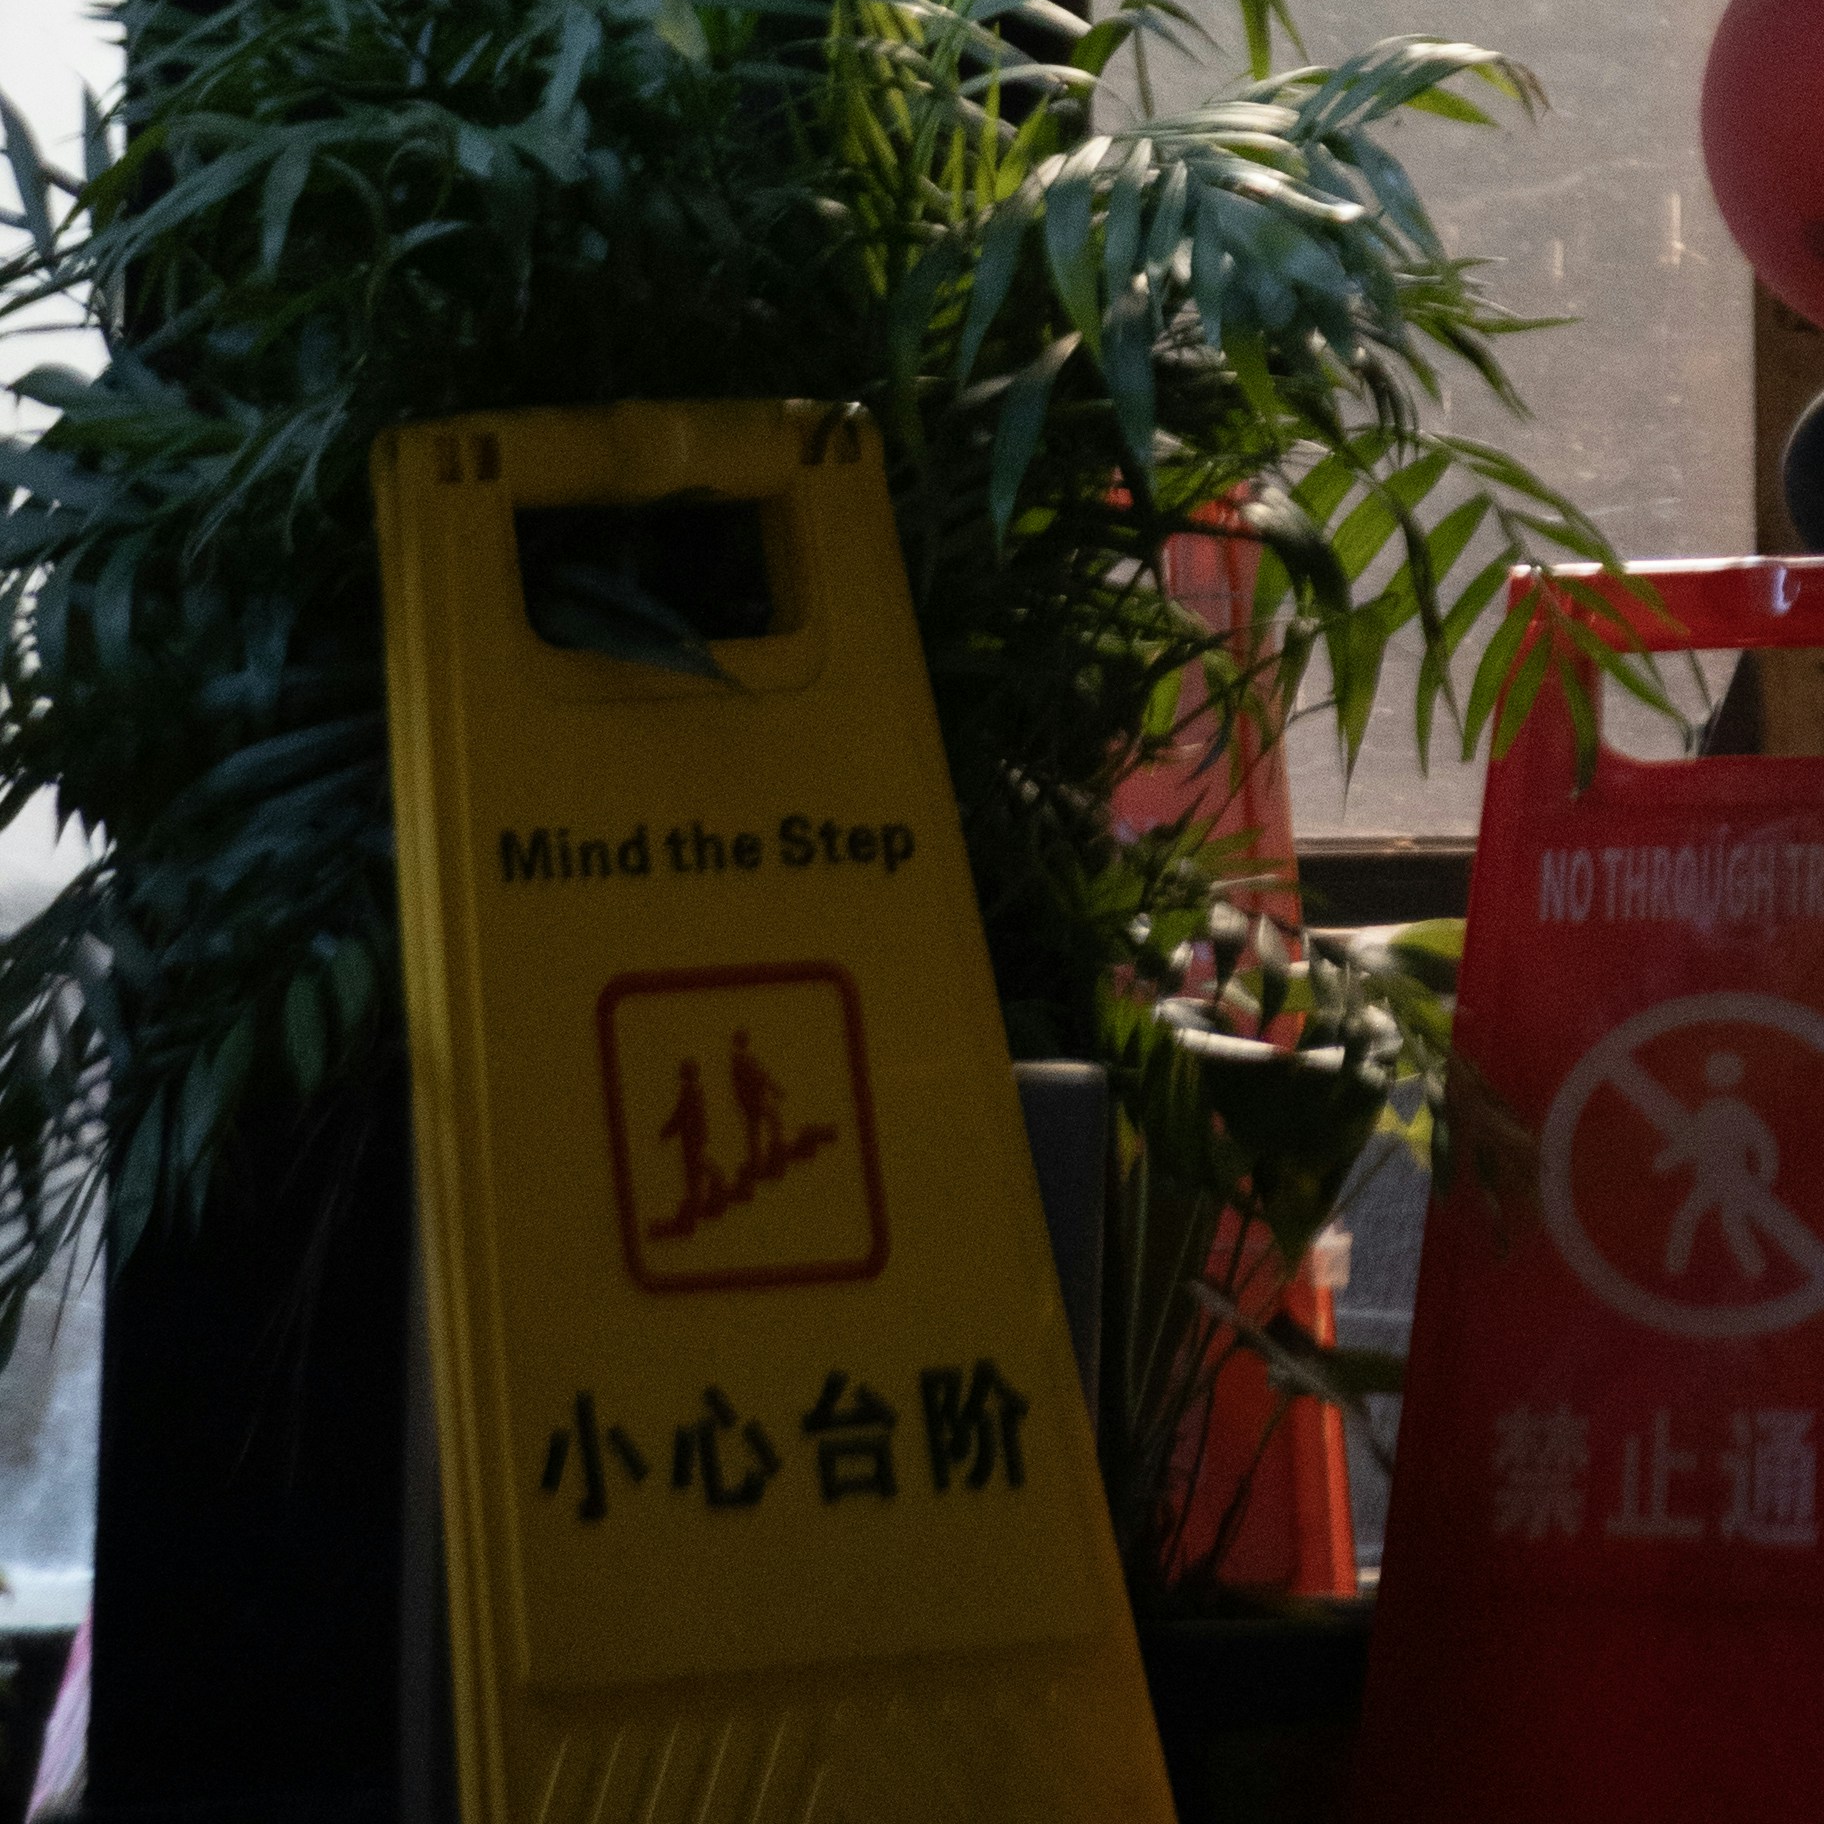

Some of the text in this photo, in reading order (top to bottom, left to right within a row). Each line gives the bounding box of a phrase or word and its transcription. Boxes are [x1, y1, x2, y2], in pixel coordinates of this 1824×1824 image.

[502, 815, 914, 881] Mind the Step
[1540, 850, 1594, 922] NO
[1604, 844, 1774, 920] THROUGH
[541, 1359, 1030, 1521] 小心台阶
